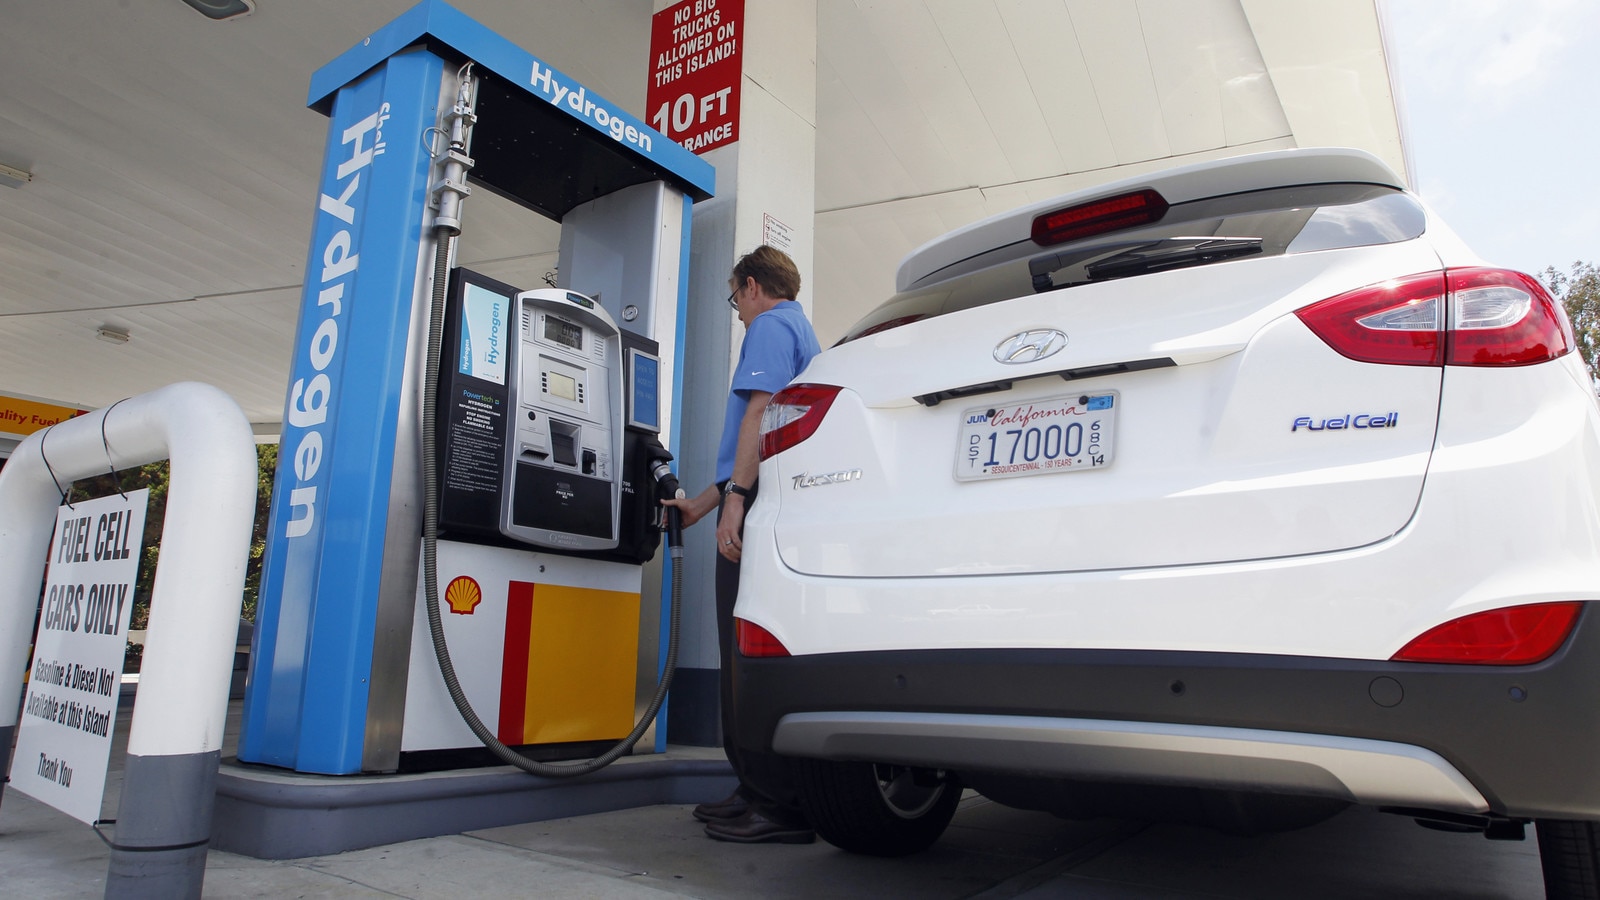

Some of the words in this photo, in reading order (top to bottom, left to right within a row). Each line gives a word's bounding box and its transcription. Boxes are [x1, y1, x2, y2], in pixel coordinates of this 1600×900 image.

[673, 9, 720, 44] TRUCKS
[674, 6, 690, 26] NO
[695, 0, 716, 16] BIG
[655, 63, 682, 87] THIS
[686, 39, 736, 75] ISLAND!
[657, 31, 713, 69] ALLOWED
[717, 21, 735, 42] ON
[530, 61, 652, 152] Hydrogen
[653, 93, 695, 137] 10
[700, 86, 732, 124] FT
[678, 122, 732, 152] RANCE
[286, 112, 379, 538] Hydrogen
[487, 302, 501, 365] Hydrogen
[462, 339, 471, 370] Hydrogen
[463, 390, 494, 403] Powertech
[967, 414, 988, 424] JUN
[990, 402, 1088, 428] California
[1291, 414, 1351, 432] Fuel
[1352, 412, 1398, 429] Cell
[983, 422, 1084, 467] 17000
[1091, 454, 1105, 467] 14
[991, 462, 1040, 474] SESQUICENTENNIAL
[1054, 458, 1073, 467] YEARS
[58, 516, 92, 564] FUEL
[94, 509, 132, 562] CELL
[45, 584, 84, 632] CARS
[84, 584, 128, 635] ONLY
[35, 657, 65, 686] Gasoline
[64, 663, 72, 688] &
[72, 664, 98, 693] Diesel
[97, 667, 115, 697] Not
[26, 691, 59, 722] Available
[58, 701, 69, 725] at
[67, 701, 83, 729] this
[82, 705, 111, 738] Island
[37, 752, 59, 782] Thank
[58, 760, 73, 788] You
